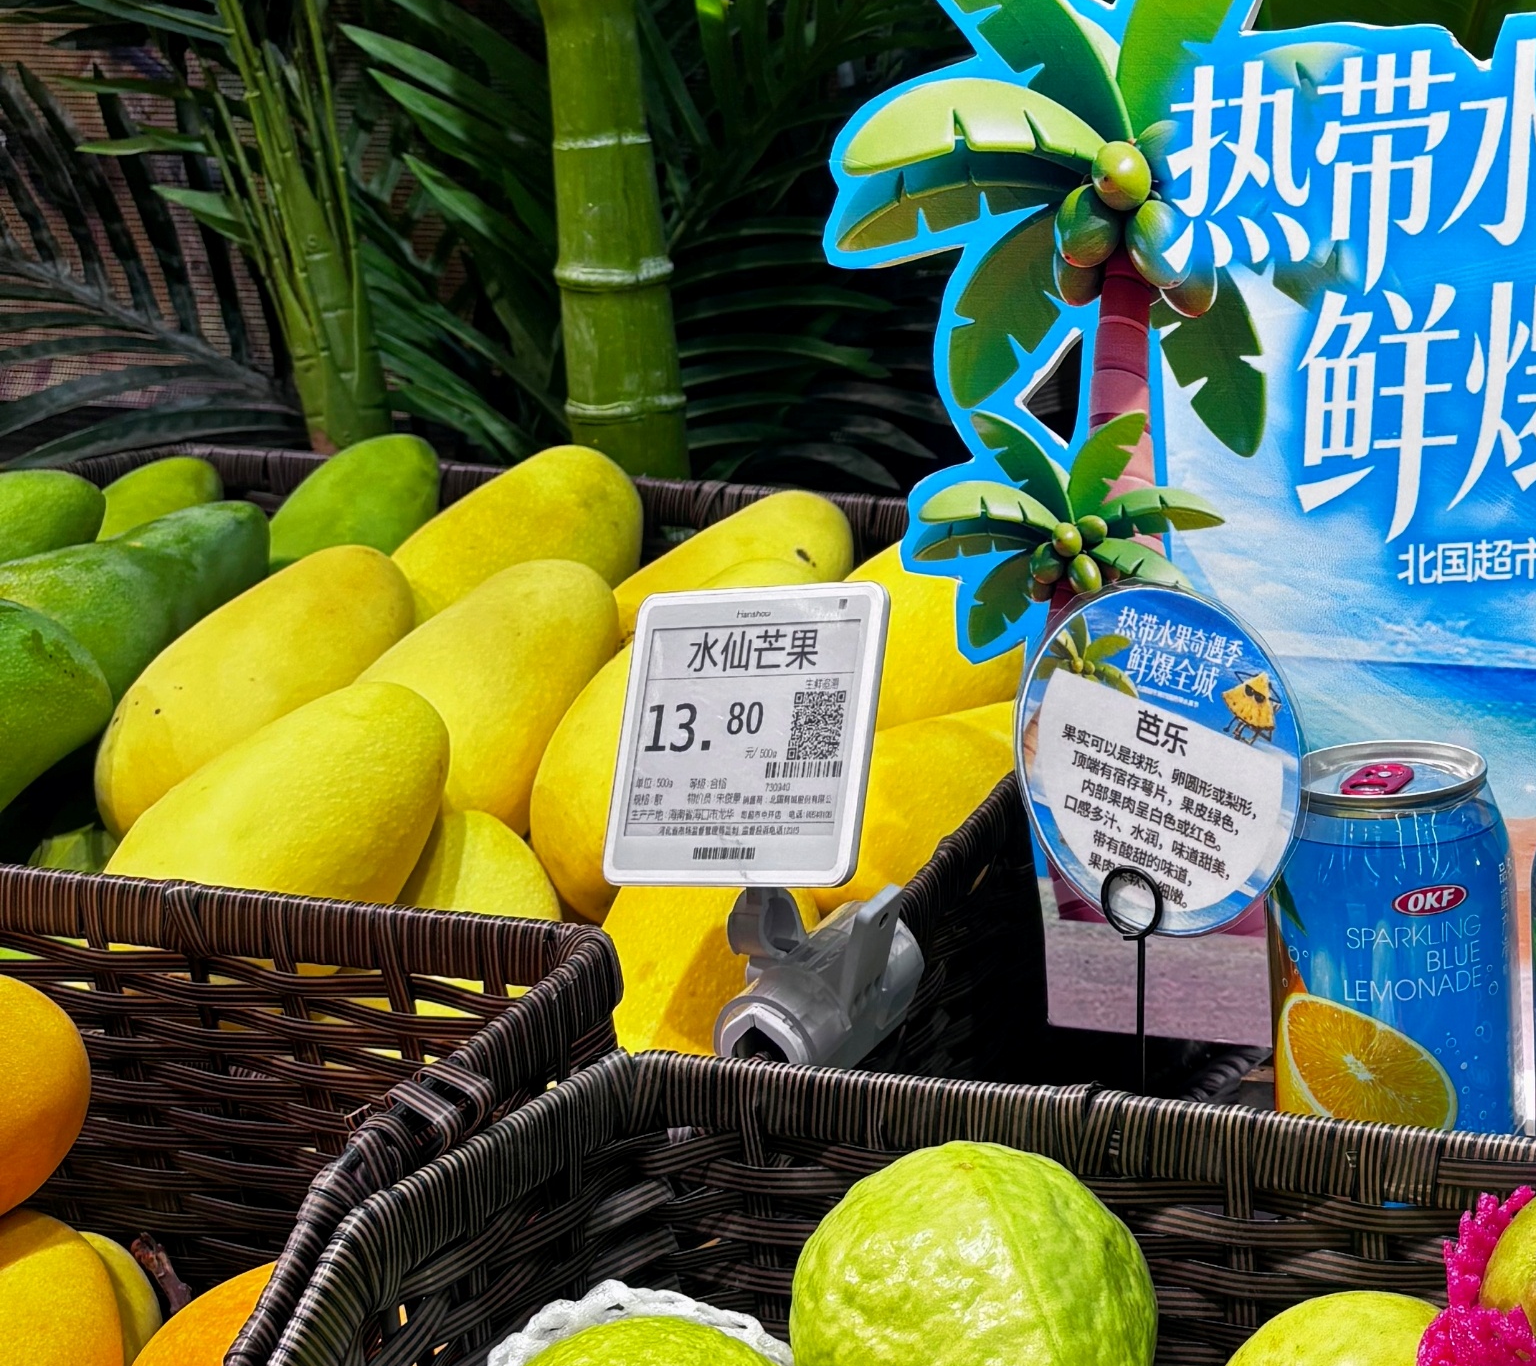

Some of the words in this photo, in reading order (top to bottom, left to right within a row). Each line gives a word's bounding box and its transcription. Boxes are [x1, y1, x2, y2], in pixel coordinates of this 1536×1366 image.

[687, 628, 819, 672] 水仙芒果
[1114, 605, 1244, 668] 热带水果奇遇季
[1124, 643, 1220, 703] 鲜爆全城
[1136, 710, 1188, 756] 芭乐
[1405, 887, 1458, 914] OKF
[1346, 913, 1482, 951] SPARKLING
[1426, 940, 1481, 974] BLUE
[1343, 964, 1482, 1003] LEMONADE
